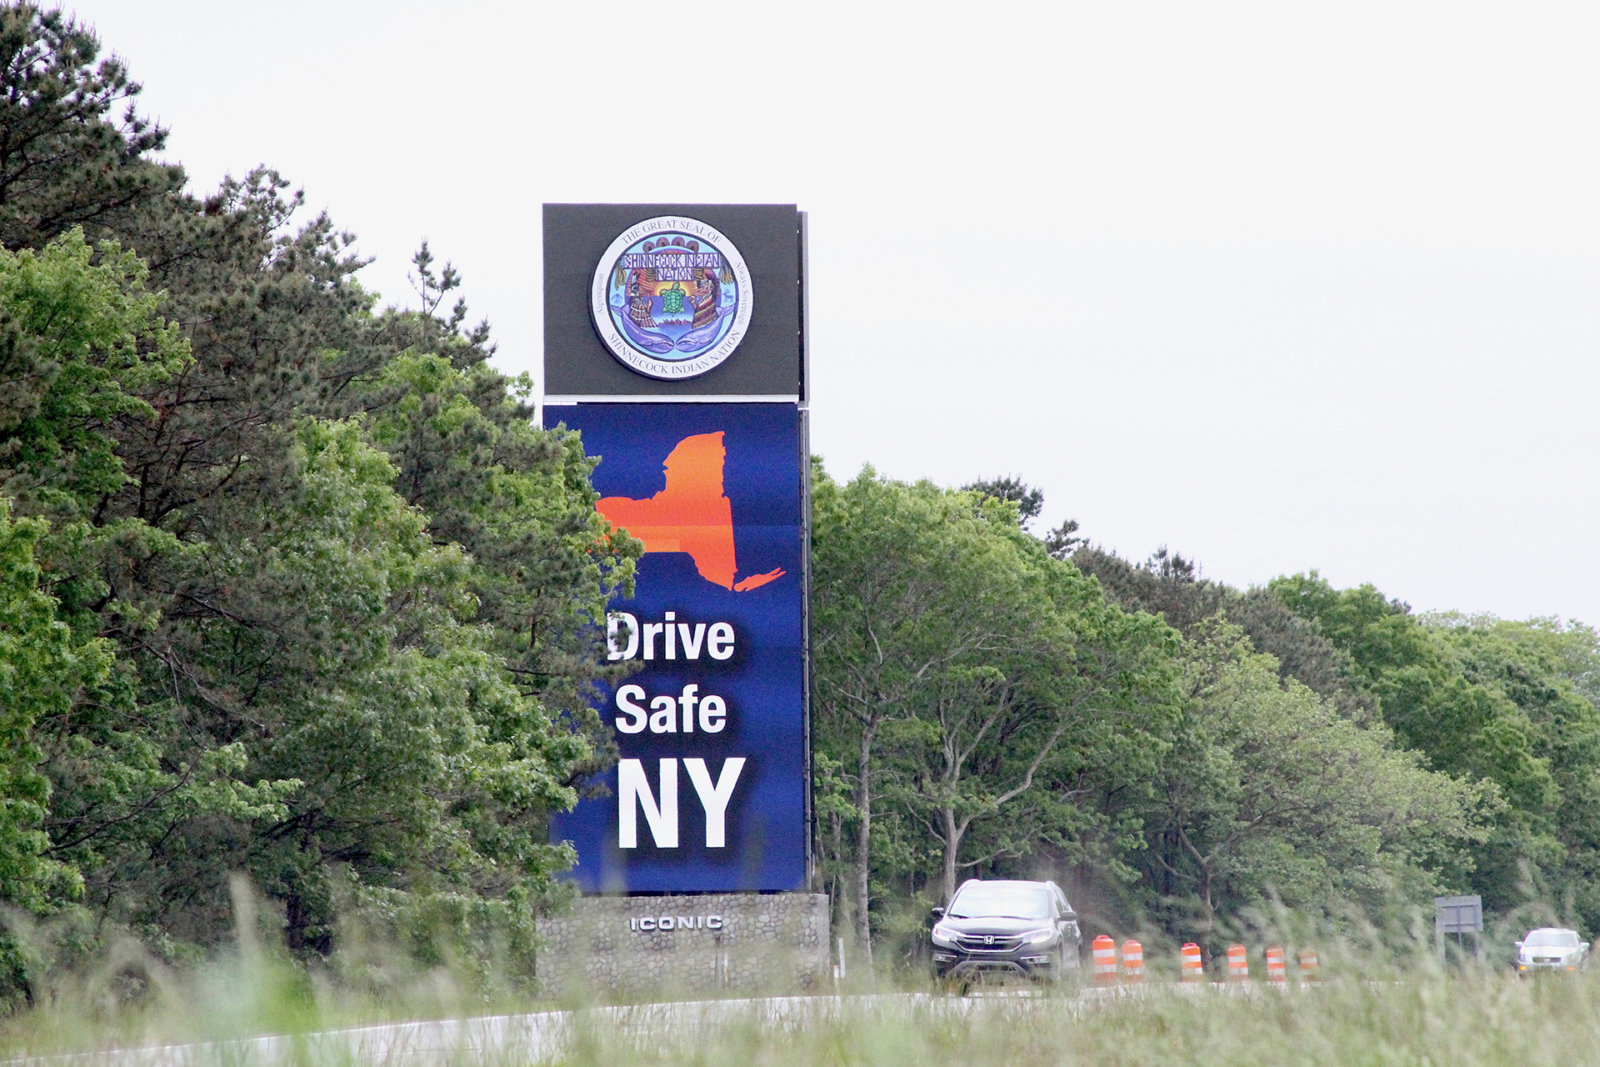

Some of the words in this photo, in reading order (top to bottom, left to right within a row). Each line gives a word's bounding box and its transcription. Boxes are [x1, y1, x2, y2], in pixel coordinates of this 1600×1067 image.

[620, 228, 643, 245] THE
[642, 219, 677, 233] GREAT
[680, 220, 705, 235] SEAL
[707, 231, 721, 243] OF
[656, 268, 694, 281] NATION
[608, 332, 668, 375] SHINNECOCK
[671, 360, 709, 375] INDIAN
[710, 330, 740, 364] NATION
[607, 611, 735, 661] Drive
[615, 684, 727, 734] Safe
[618, 757, 747, 849] NY
[630, 915, 723, 931] ICONIC
